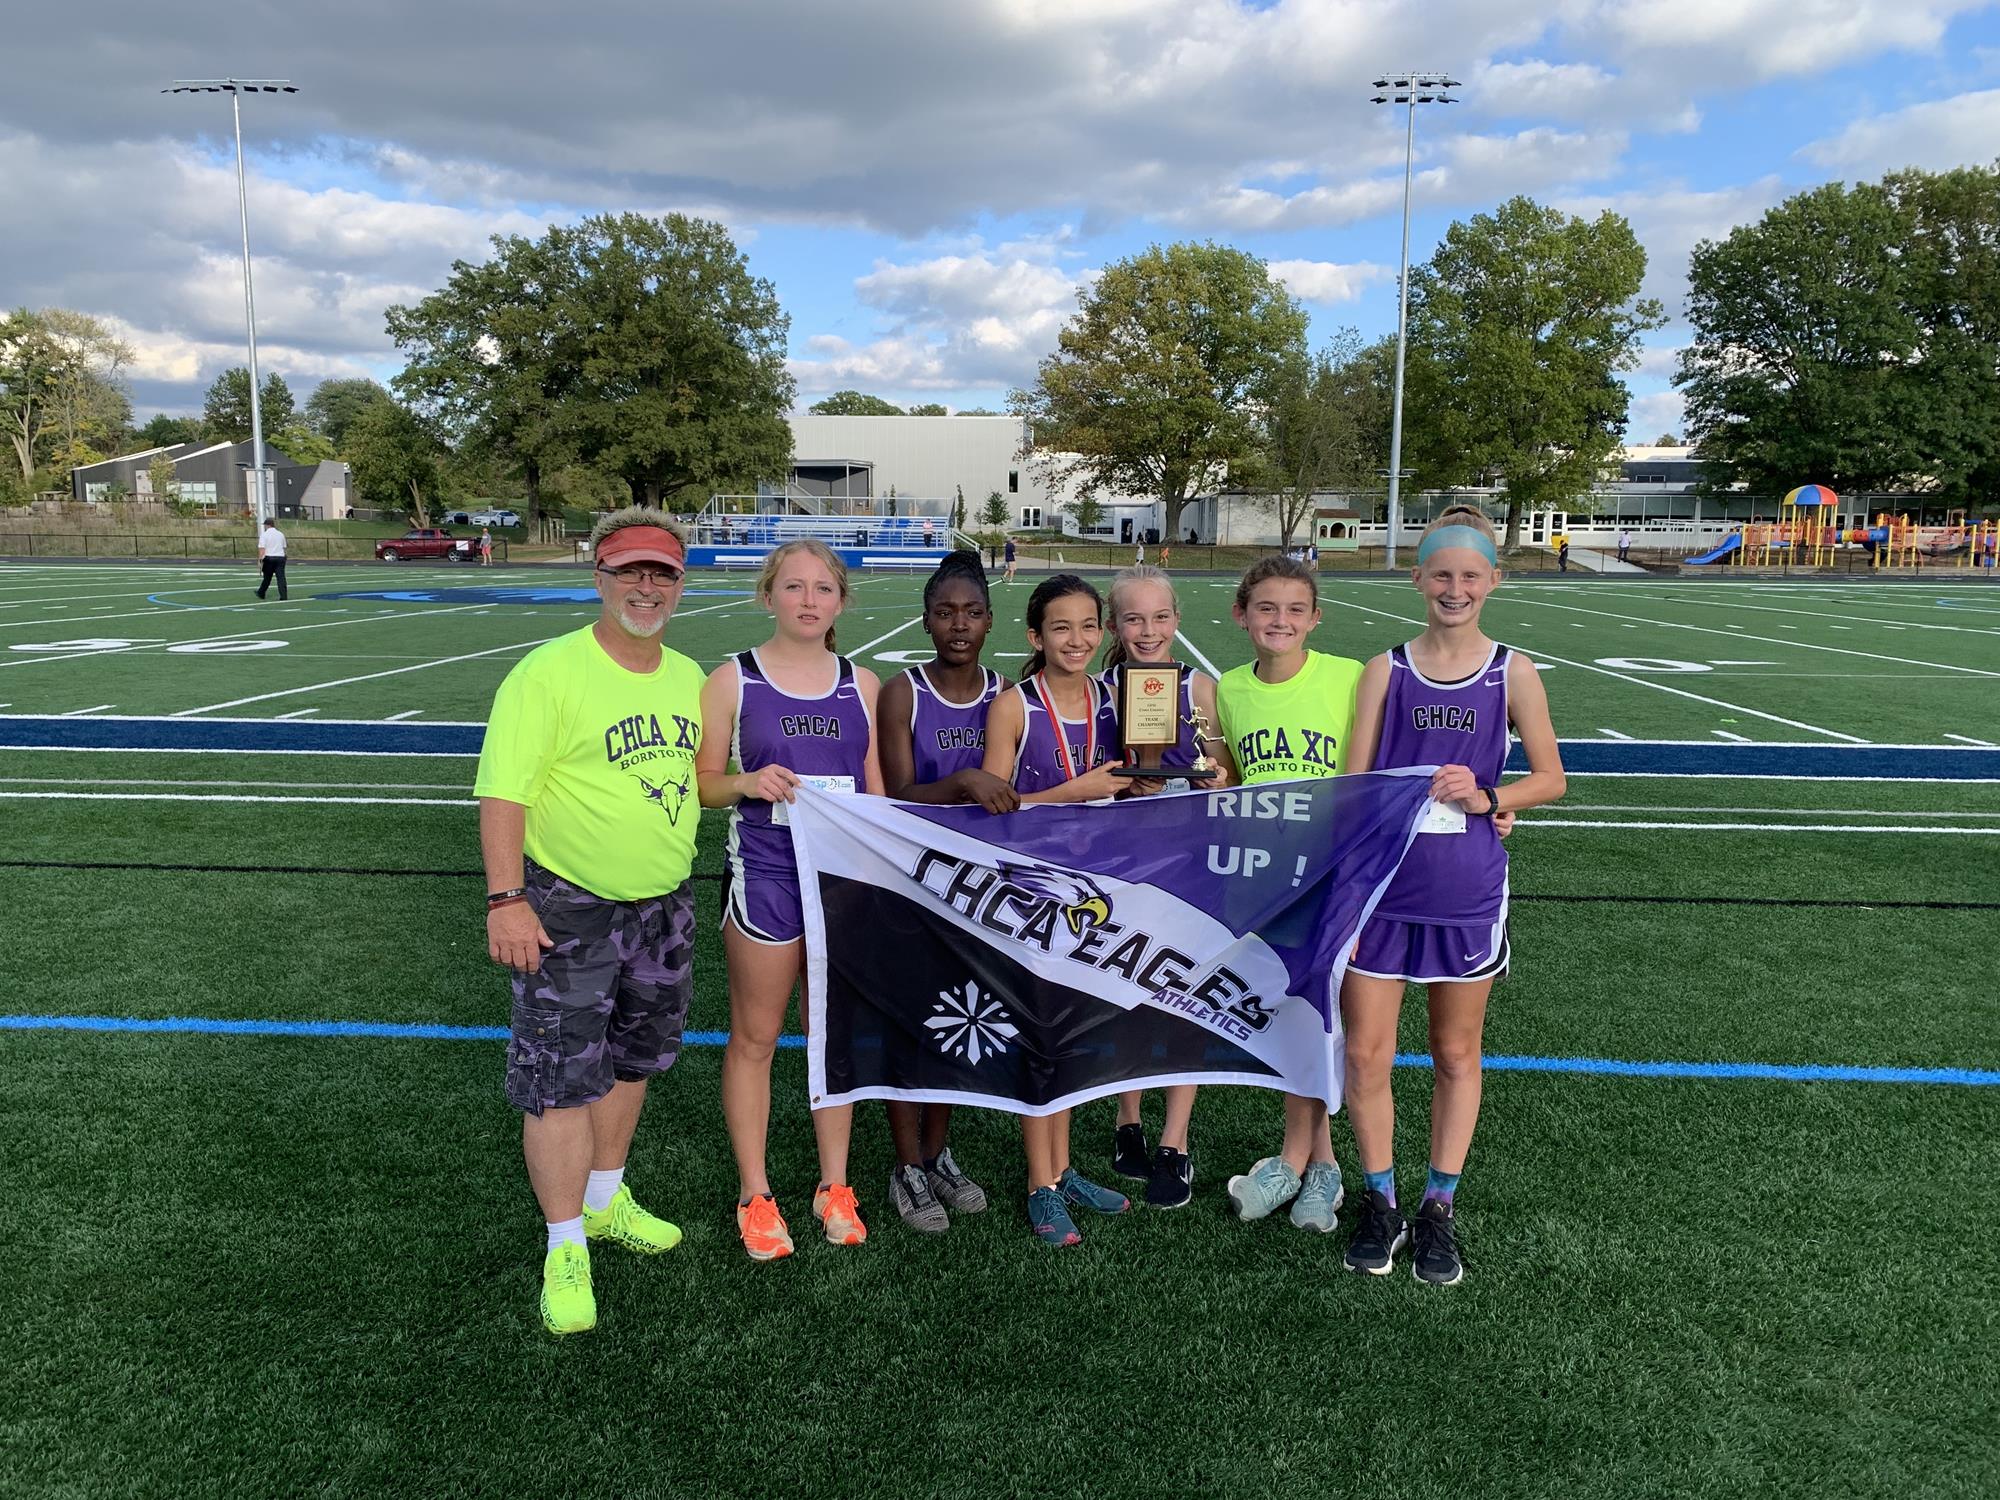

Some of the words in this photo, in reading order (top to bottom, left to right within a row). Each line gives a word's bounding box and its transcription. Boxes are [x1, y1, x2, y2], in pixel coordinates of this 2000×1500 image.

[779, 714, 841, 740] CHCA
[1412, 704, 1477, 734] CHCA
[605, 713, 668, 763] CHCA
[935, 726, 985, 752] CHCA
[1301, 728, 1337, 770] XC
[620, 749, 658, 771] BORN
[657, 749, 675, 759] TO
[1278, 762, 1298, 772] TO
[1302, 763, 1328, 778] FLY
[1207, 791, 1313, 822] RISE
[1207, 844, 1271, 878] UP
[910, 847, 1064, 954] CHCA
[1064, 921, 1279, 1034] EAGES
[1151, 988, 1253, 1042] ATHLETICS
